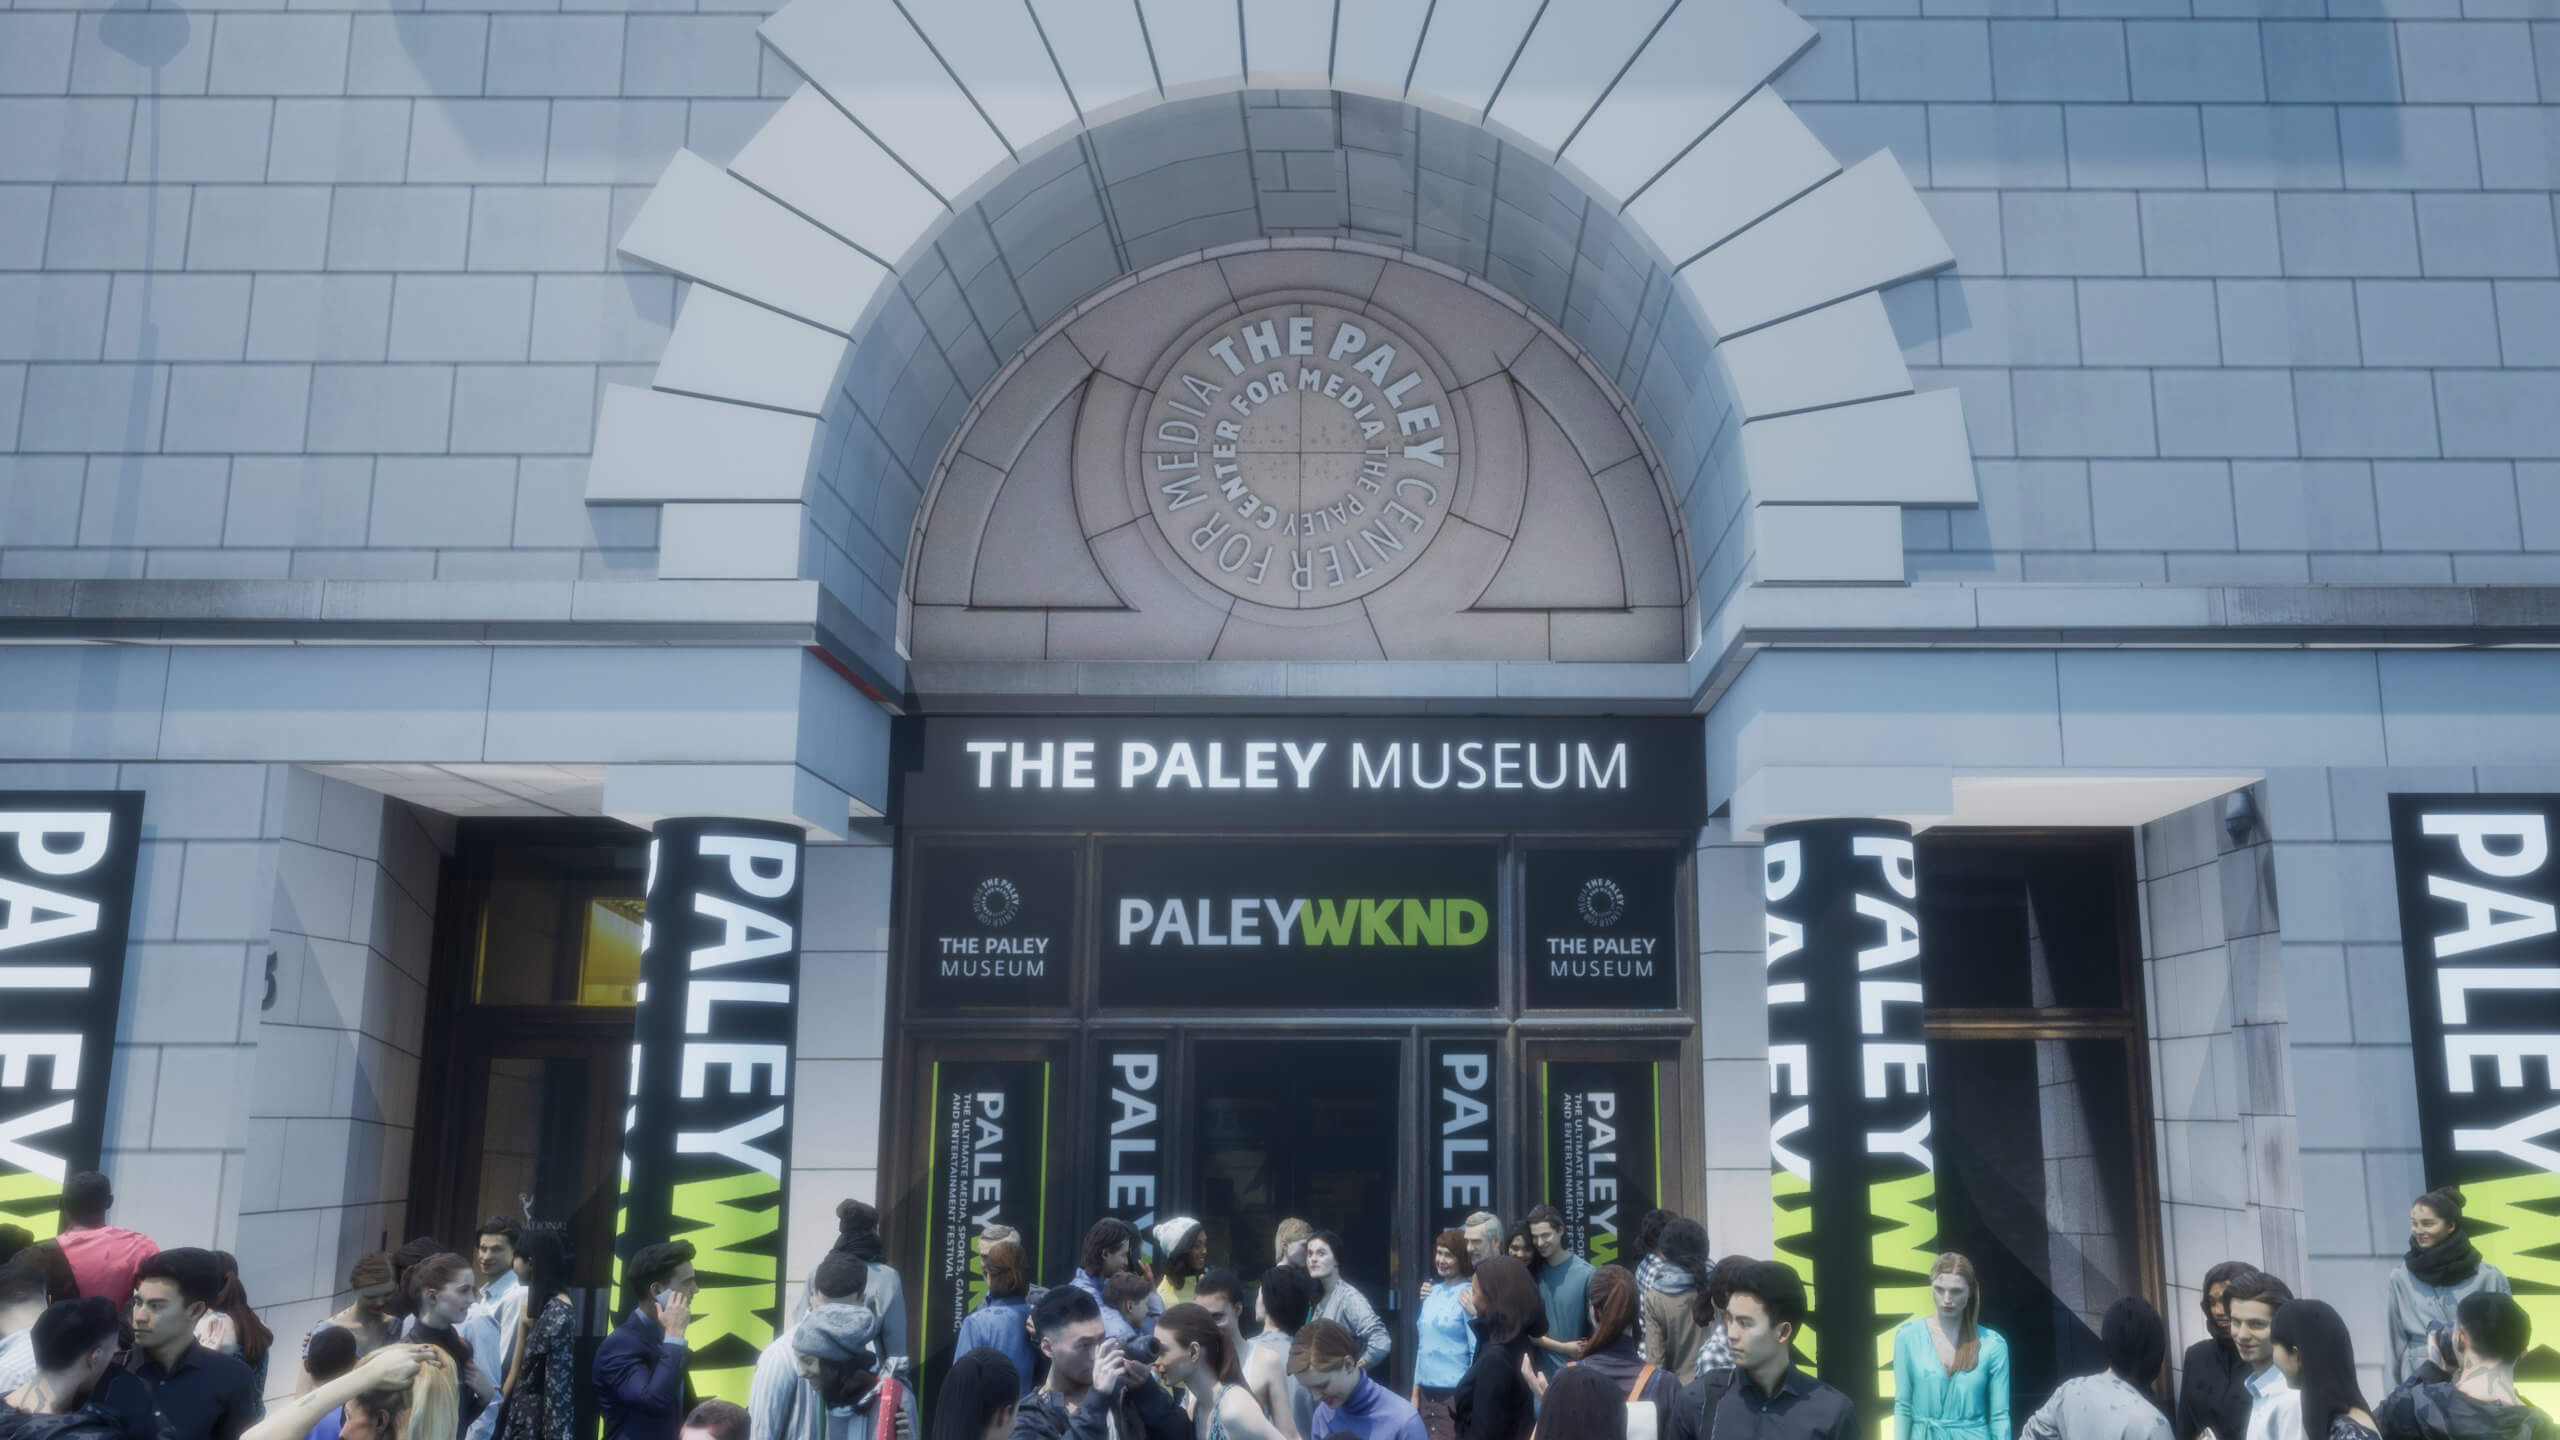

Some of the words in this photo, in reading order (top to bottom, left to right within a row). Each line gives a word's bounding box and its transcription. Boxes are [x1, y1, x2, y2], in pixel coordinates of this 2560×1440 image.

[1208, 317, 1315, 376] THE
[1231, 370, 1289, 417] FOR
[1299, 368, 1386, 440] MEDIA
[1328, 322, 1445, 469] PALEY
[1158, 374, 1223, 512] MEDIA
[1213, 421, 1278, 530] CENTER
[1355, 446, 1390, 495] THE
[1282, 493, 1366, 537] PALEY
[1291, 477, 1438, 591] CENTER
[1191, 511, 1273, 585] FOR
[966, 742, 1096, 788] THE
[1121, 742, 1327, 788] PALEY
[1352, 742, 1628, 789] MUSEUM
[939, 938, 980, 954] THE
[985, 938, 1049, 954] PALEY
[941, 960, 1044, 977] MUSEUM
[1546, 938, 1587, 954] THE
[1593, 938, 1656, 954] PALEY
[1551, 960, 1653, 977] MUSEUM
[952, 1093, 961, 1120] AND
[963, 1093, 972, 1117] THE
[1563, 1093, 1572, 1120] AND
[1574, 1093, 1583, 1117] THE
[961, 1119, 970, 1177] ULTIMATE
[1443, 1054, 1489, 1232] PALE
[1574, 1119, 1584, 1177] ULTIMATE
[947, 1122, 960, 1223] ENTERTAINMENT
[1564, 1122, 1574, 1223] ENTERTAINMENT
[958, 1180, 968, 1223] MEDIA,
[1575, 1180, 1585, 1223] MEDIA,
[945, 1225, 956, 1280] FESTIVAL
[955, 1225, 967, 1276] SPORTS,
